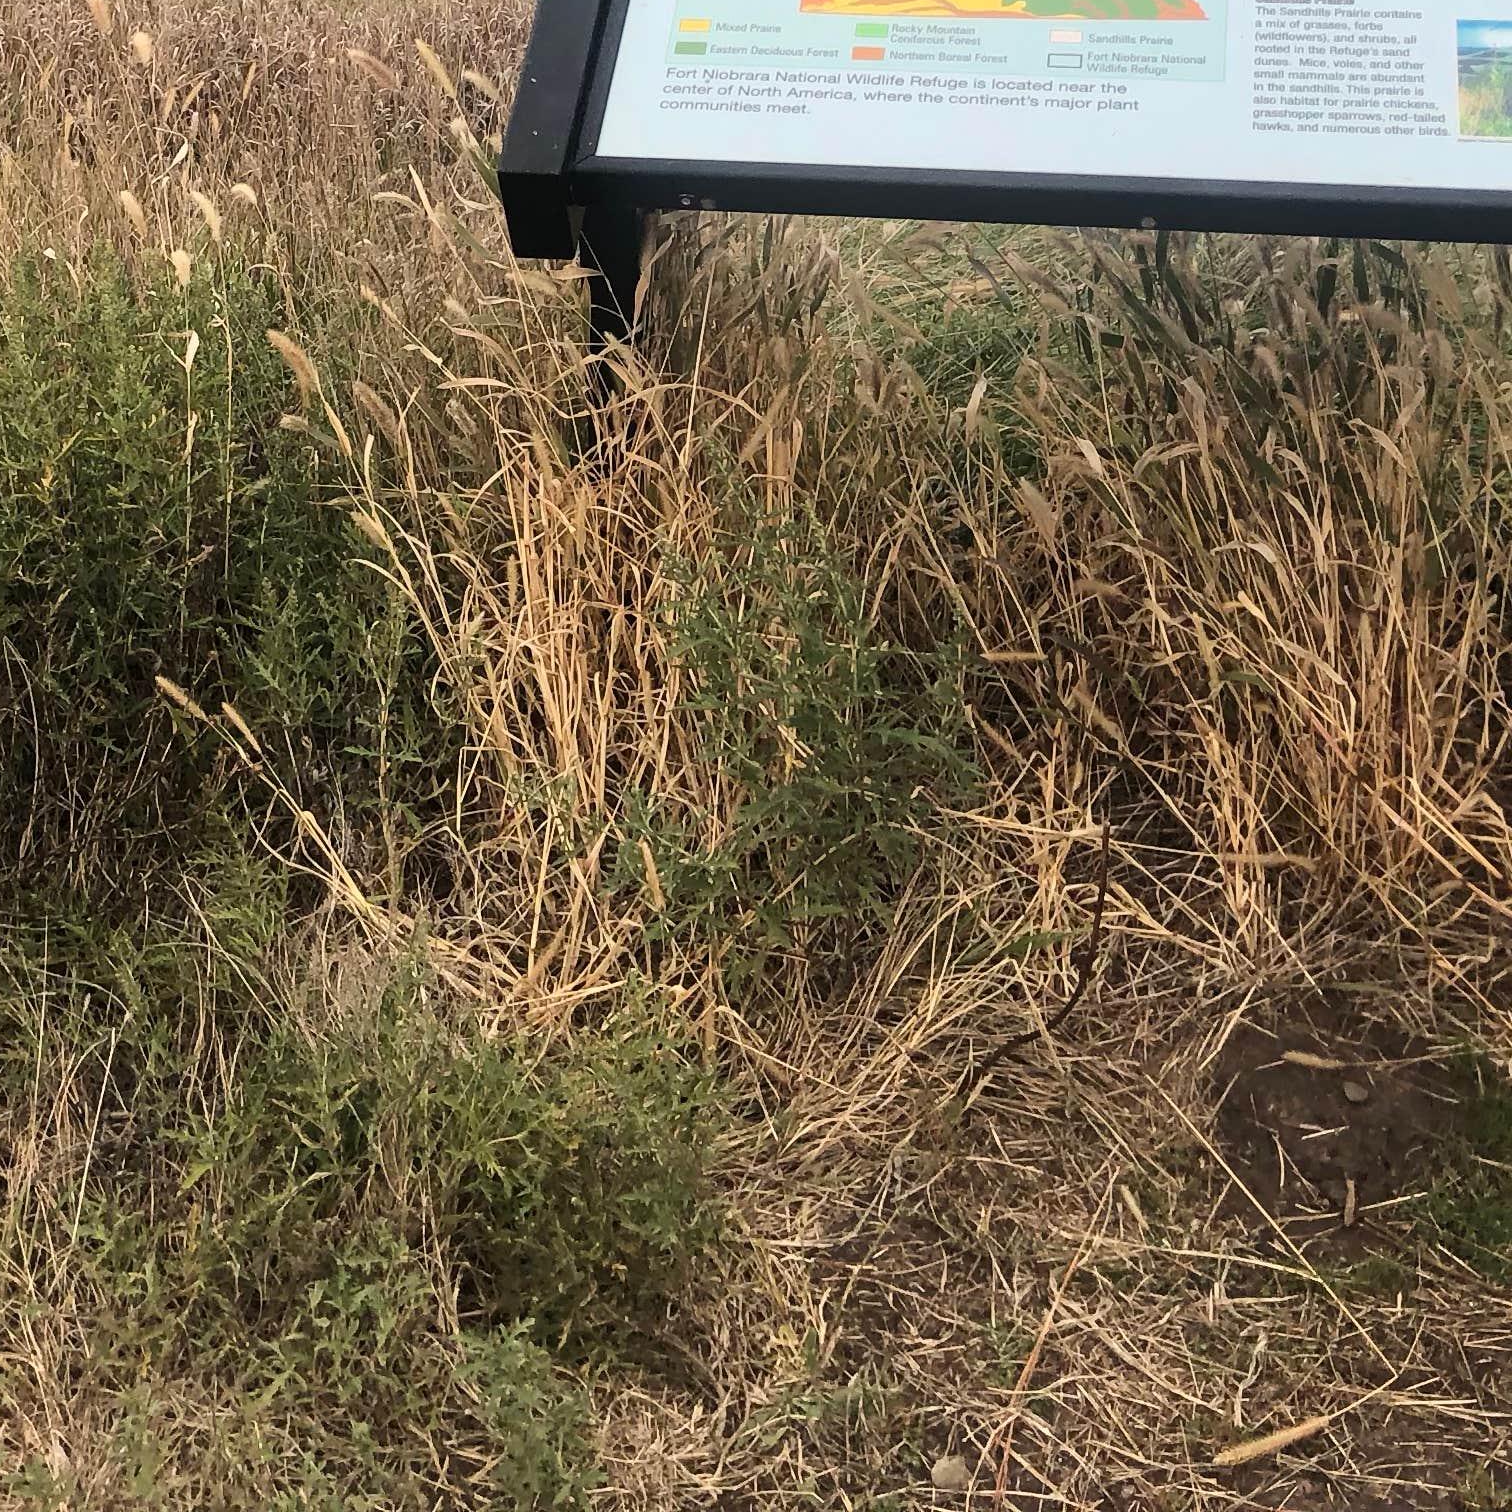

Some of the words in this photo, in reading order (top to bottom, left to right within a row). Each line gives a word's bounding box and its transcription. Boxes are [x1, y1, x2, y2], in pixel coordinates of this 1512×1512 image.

[1255, 6, 1276, 16] The
[1279, 7, 1331, 18] Sandhills
[1334, 8, 1371, 18] Prairie
[1374, 10, 1422, 19] contains
[715, 23, 748, 32] Mixed
[750, 23, 782, 33] Prairie
[892, 24, 924, 35] Rocky
[926, 25, 976, 35] Mountain
[1255, 20, 1262, 28] a
[1265, 19, 1286, 28] mix
[1289, 19, 1300, 29] of
[1354, 21, 1383, 31] forbs
[890, 35, 946, 45] Coniferous
[948, 36, 982, 46] Forest
[1088, 33, 1137, 44] Sandhills
[1139, 35, 1174, 47] Prairie
[1333, 34, 1355, 43] and
[1403, 35, 1417, 44] all
[710, 45, 748, 54] Eastern
[750, 45, 804, 56] Deciduous
[805, 47, 839, 58] Forest
[889, 50, 936, 61] Northern
[938, 52, 972, 62] Boreal
[973, 53, 1008, 64] Forest
[1254, 44, 1291, 54] rooted
[1294, 45, 1304, 54] in
[1308, 45, 1326, 55] the
[1329, 46, 1379, 58] Refuge's
[1382, 48, 1410, 57] sand
[1087, 52, 1108, 62] Fort
[1112, 52, 1158, 63] Niobrara
[1160, 54, 1206, 65] National
[1369, 60, 1391, 69] and
[1394, 61, 1424, 70] other
[1086, 64, 1128, 73] Wildlife
[1130, 64, 1168, 76] Refuge
[1253, 70, 1284, 79] small
[1288, 71, 1346, 81] mammals
[1347, 73, 1367, 82] are
[1370, 73, 1425, 83] abundant
[666, 67, 697, 79] Fort
[702, 69, 770, 84] Niobrara
[775, 71, 841, 84] National
[846, 73, 905, 86] Wildlife
[910, 75, 968, 91] Refuge
[973, 78, 986, 89] is
[992, 78, 1053, 91] located
[1058, 83, 1096, 93] near
[1100, 82, 1128, 94] the
[1253, 82, 1264, 91] in
[1267, 82, 1286, 92] the
[1346, 84, 1371, 95] This
[1374, 86, 1411, 97] prairie
[1414, 86, 1424, 96] is
[662, 84, 713, 95] center
[717, 84, 734, 95] of
[738, 85, 782, 97] North
[786, 87, 857, 101] America,
[863, 90, 912, 102] where
[918, 92, 944, 103] the
[948, 94, 1039, 107] continent's
[1044, 97, 1093, 111] major
[1097, 98, 1139, 112] plant
[1253, 95, 1277, 105] also
[1280, 96, 1320, 106] habitat
[1323, 97, 1339, 108] for
[1342, 98, 1380, 109] prairie
[659, 100, 761, 113] communities
[766, 104, 811, 114] meet.
[1252, 109, 1325, 121] grasshopper
[1388, 113, 1446, 123] red-tailed
[1296, 123, 1319, 132] and
[1322, 125, 1381, 134] numerous
[1384, 125, 1415, 135] other
